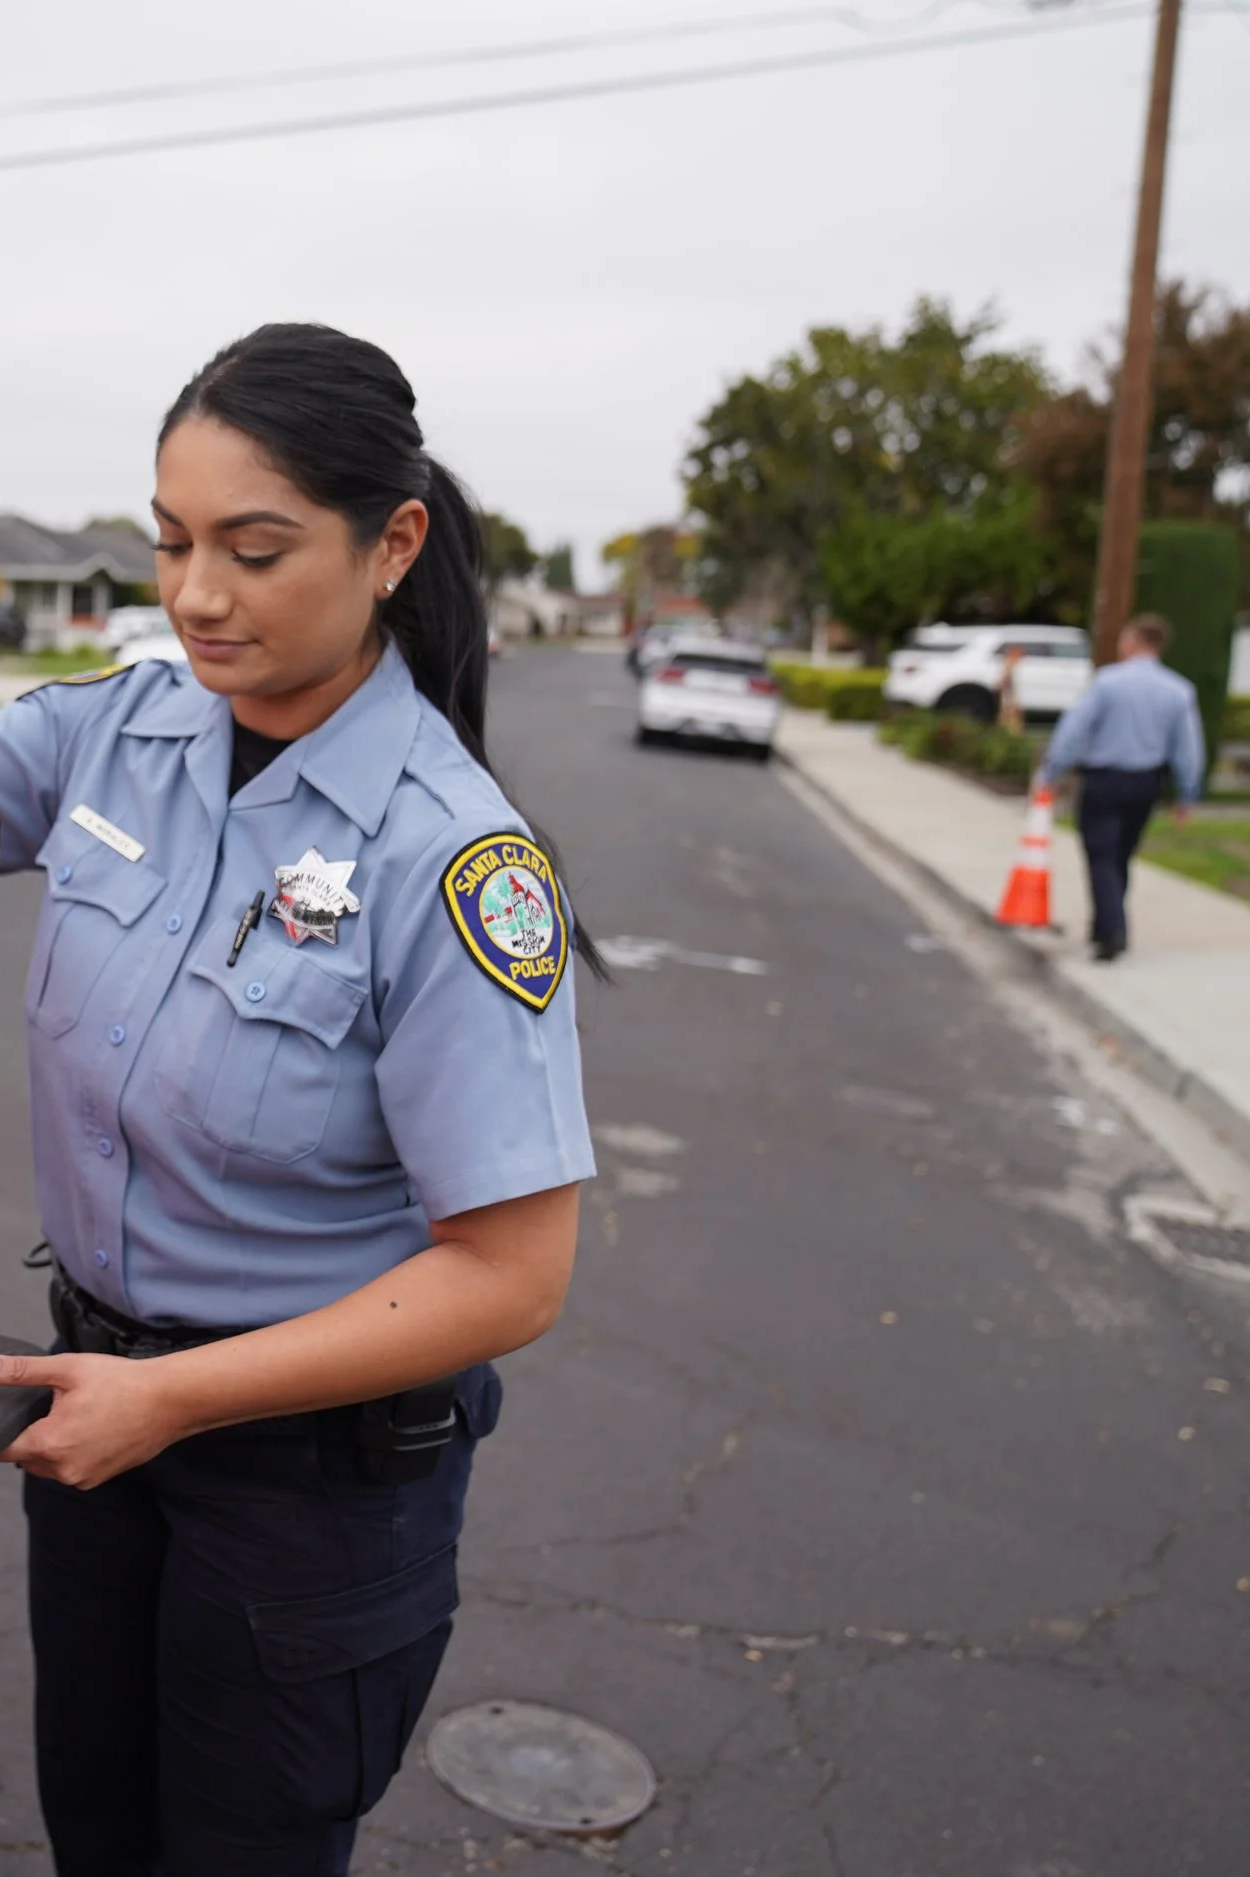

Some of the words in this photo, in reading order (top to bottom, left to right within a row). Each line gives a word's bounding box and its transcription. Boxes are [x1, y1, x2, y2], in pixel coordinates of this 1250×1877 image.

[455, 847, 502, 897] SANTA
[502, 844, 549, 884] CLARA
[522, 928, 538, 941] THE
[511, 937, 546, 949] MISSION
[523, 945, 542, 956] CITY
[509, 956, 557, 981] POLICE
